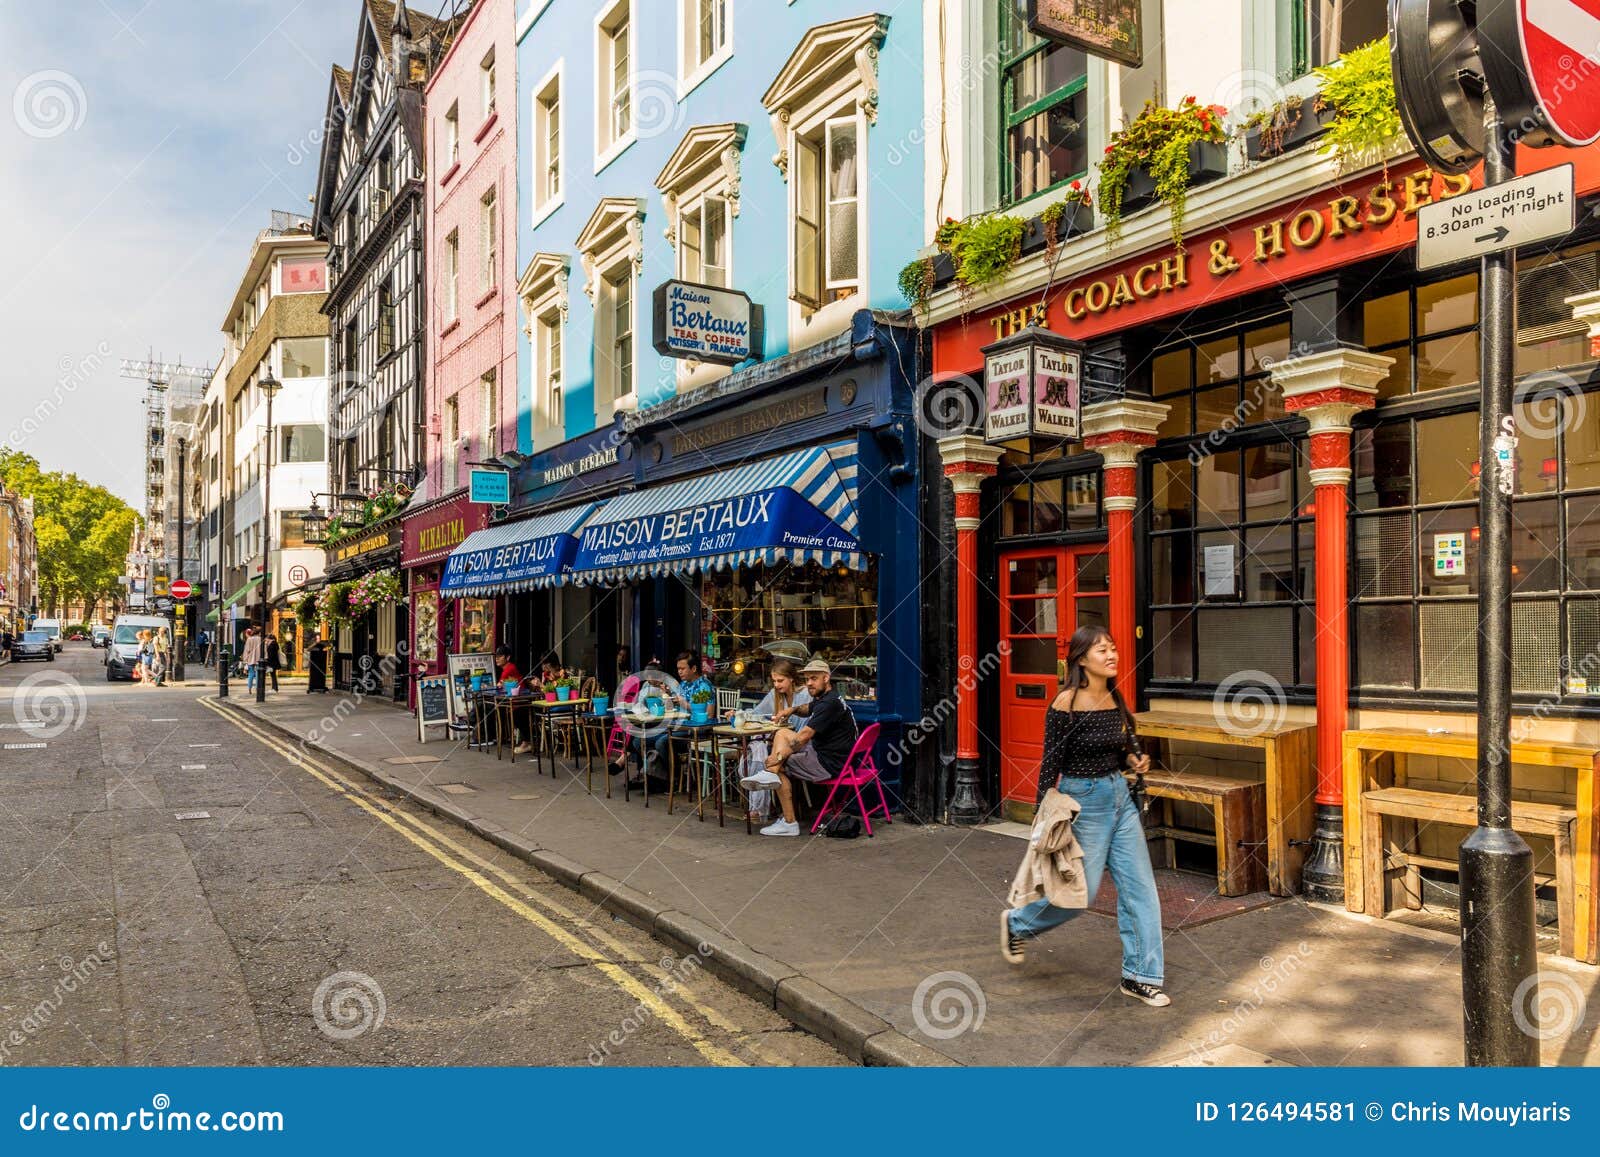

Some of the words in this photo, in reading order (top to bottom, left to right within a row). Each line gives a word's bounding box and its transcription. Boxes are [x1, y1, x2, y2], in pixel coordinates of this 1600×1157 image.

[1080, 6, 1098, 21] THE
[1426, 215, 1484, 239] 8.30am
[1502, 191, 1565, 218] M'night
[1451, 204, 1473, 218] No
[1478, 186, 1536, 210] loading
[1063, 251, 1190, 322] COACH
[1209, 237, 1241, 277] &
[670, 287, 711, 304] Maison
[669, 301, 748, 336] Bertaux
[673, 328, 698, 340] TEAS
[704, 333, 742, 347] COFFEE
[992, 358, 1025, 377] TAYLOR
[1039, 354, 1074, 374] TAYLOR
[990, 412, 1027, 429] WALKER
[1038, 408, 1075, 428] WALKER
[674, 421, 738, 453] PATISSERIE
[543, 462, 574, 484] MAISON
[579, 447, 618, 473] BERTAUX
[419, 518, 465, 553] MINALIMA
[582, 517, 656, 552] MAISON
[660, 492, 776, 541] BERTAUX
[447, 551, 493, 574] MAISON
[493, 536, 559, 569] BERTAUX
[594, 550, 619, 566] Creating
[619, 548, 637, 562] Daily
[637, 550, 647, 559] on
[646, 547, 659, 558] the
[658, 541, 692, 557] Premises
[826, 536, 857, 550] Classe
